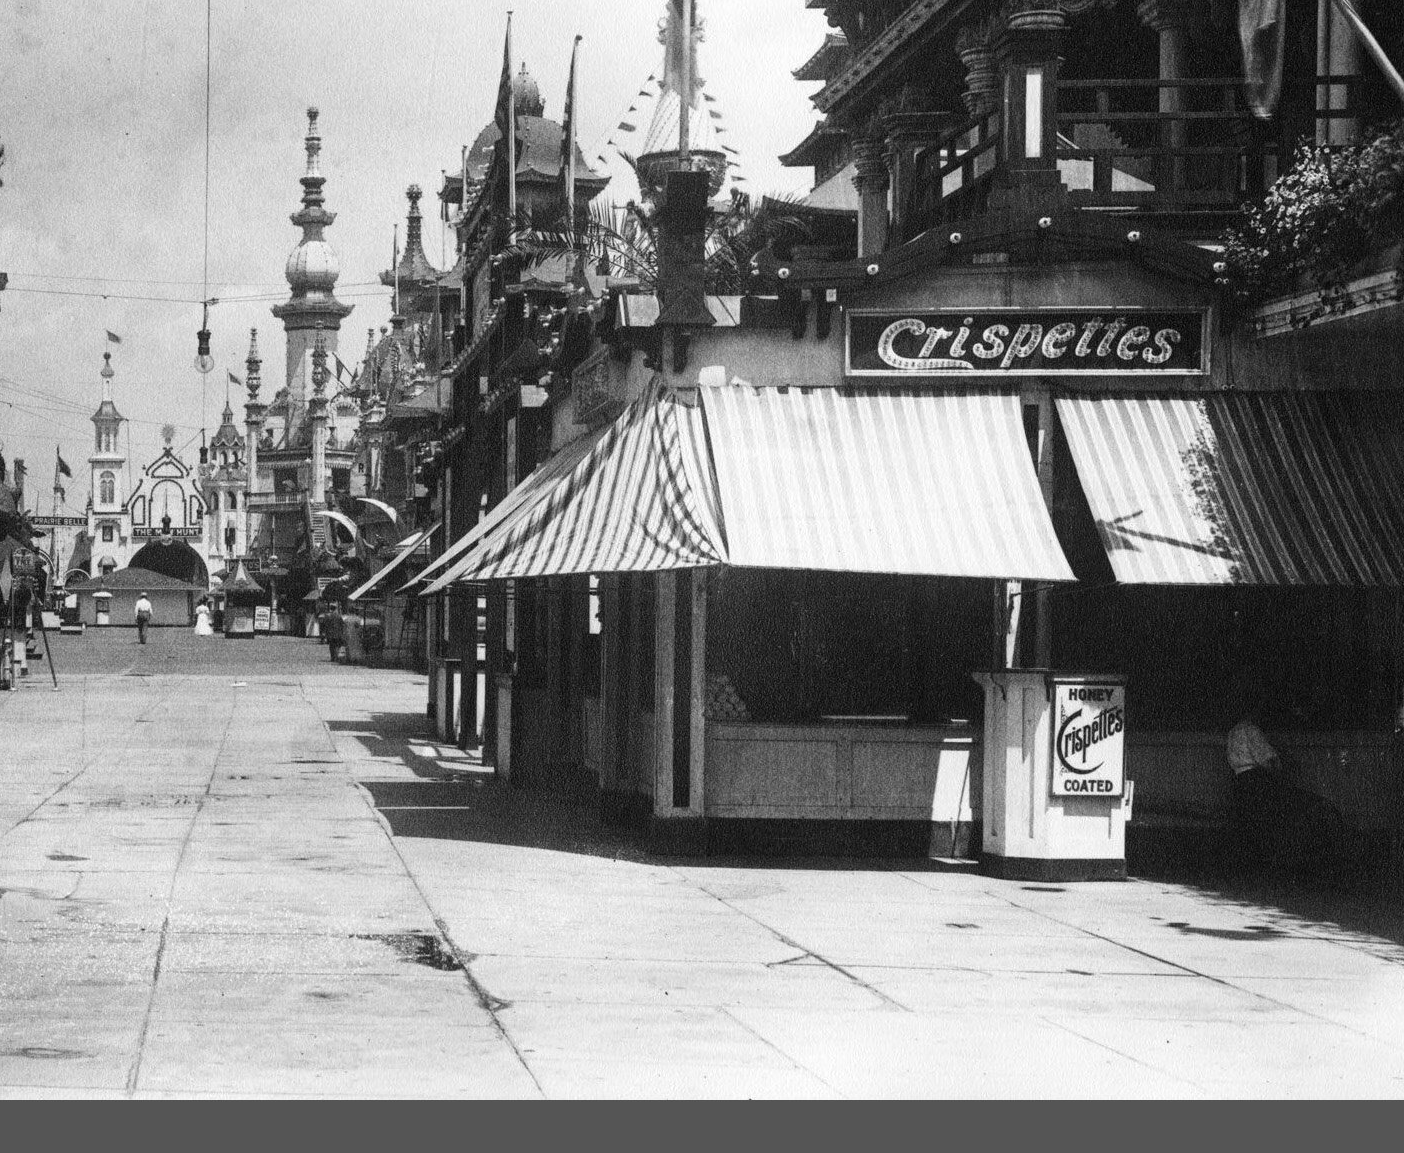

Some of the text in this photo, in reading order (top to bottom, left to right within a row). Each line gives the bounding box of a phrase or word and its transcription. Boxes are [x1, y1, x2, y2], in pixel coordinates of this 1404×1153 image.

[877, 317, 1182, 370] Crispettes
[136, 528, 152, 536] THE
[176, 528, 199, 536] HUNT
[1069, 688, 1114, 701] HONEY
[1056, 706, 1124, 775] Crispettes
[1064, 779, 1113, 792] COATED
